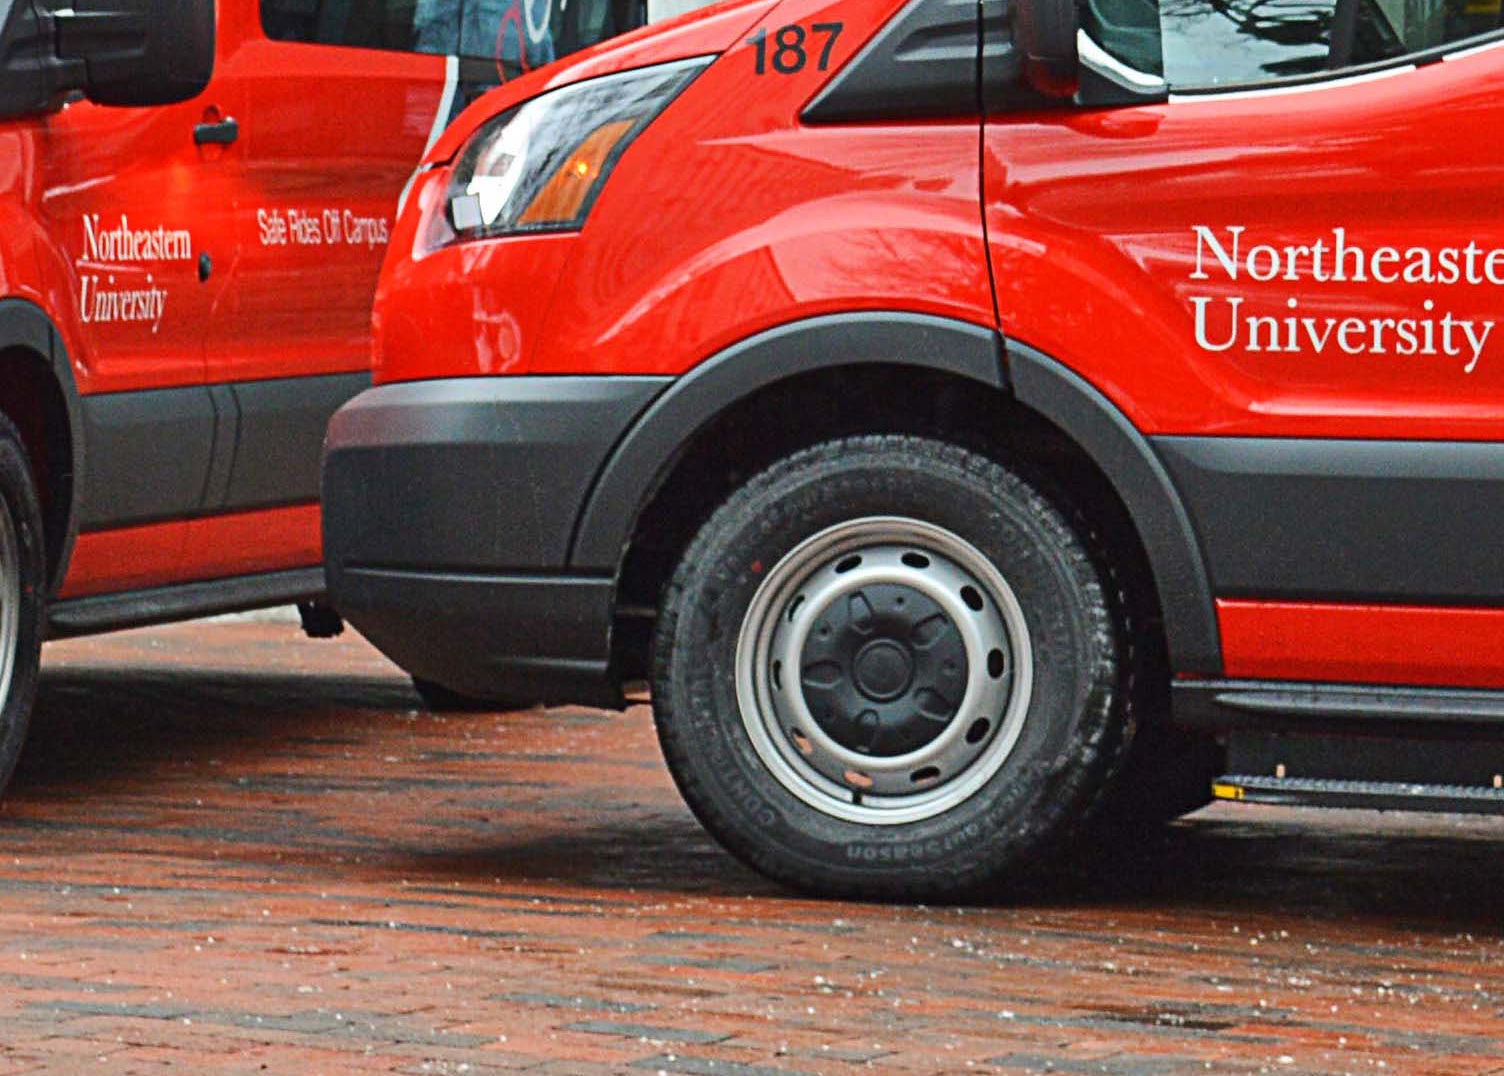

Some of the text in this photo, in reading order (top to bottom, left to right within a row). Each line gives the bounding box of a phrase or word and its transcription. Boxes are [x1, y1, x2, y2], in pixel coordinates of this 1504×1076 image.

[745, 22, 845, 75] 187
[81, 212, 192, 261] Northeastern
[257, 208, 389, 250] Safe Rides Off Campus
[80, 272, 168, 333] University
[1189, 295, 1496, 374] University
